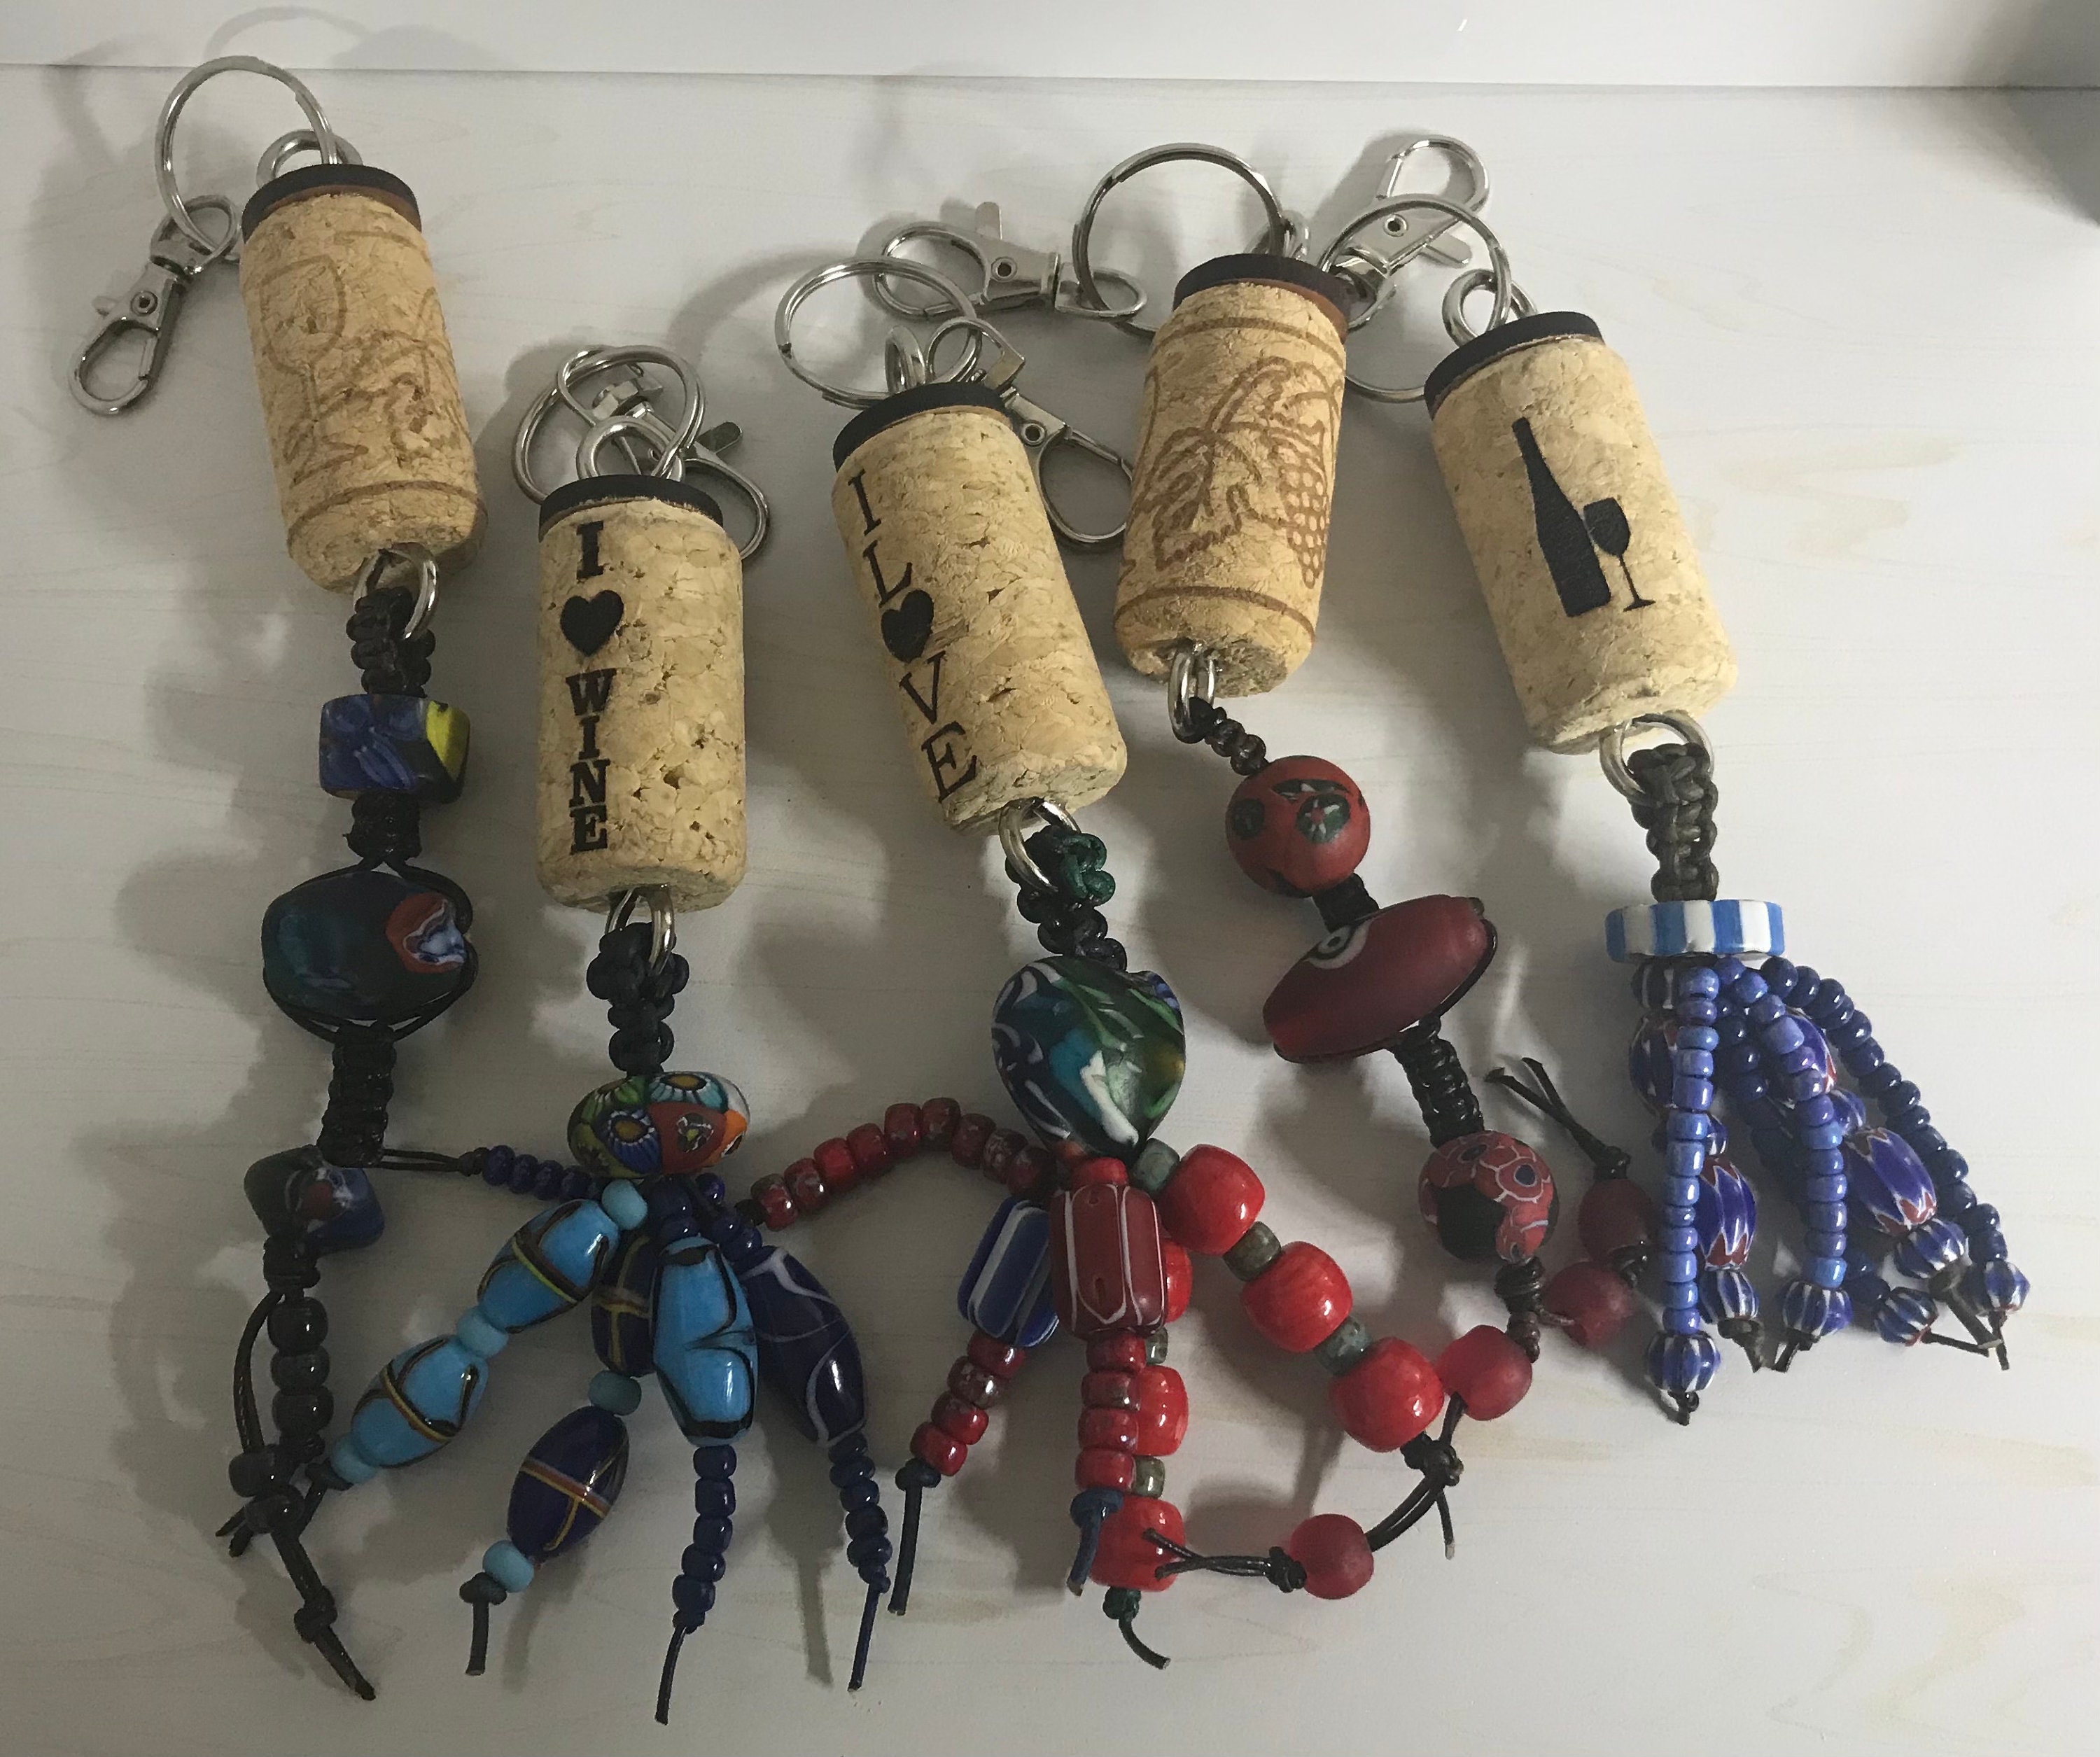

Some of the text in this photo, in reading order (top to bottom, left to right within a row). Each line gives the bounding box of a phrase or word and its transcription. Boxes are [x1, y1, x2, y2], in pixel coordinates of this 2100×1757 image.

[848, 468, 881, 535] I
[566, 520, 617, 855] I WINE
